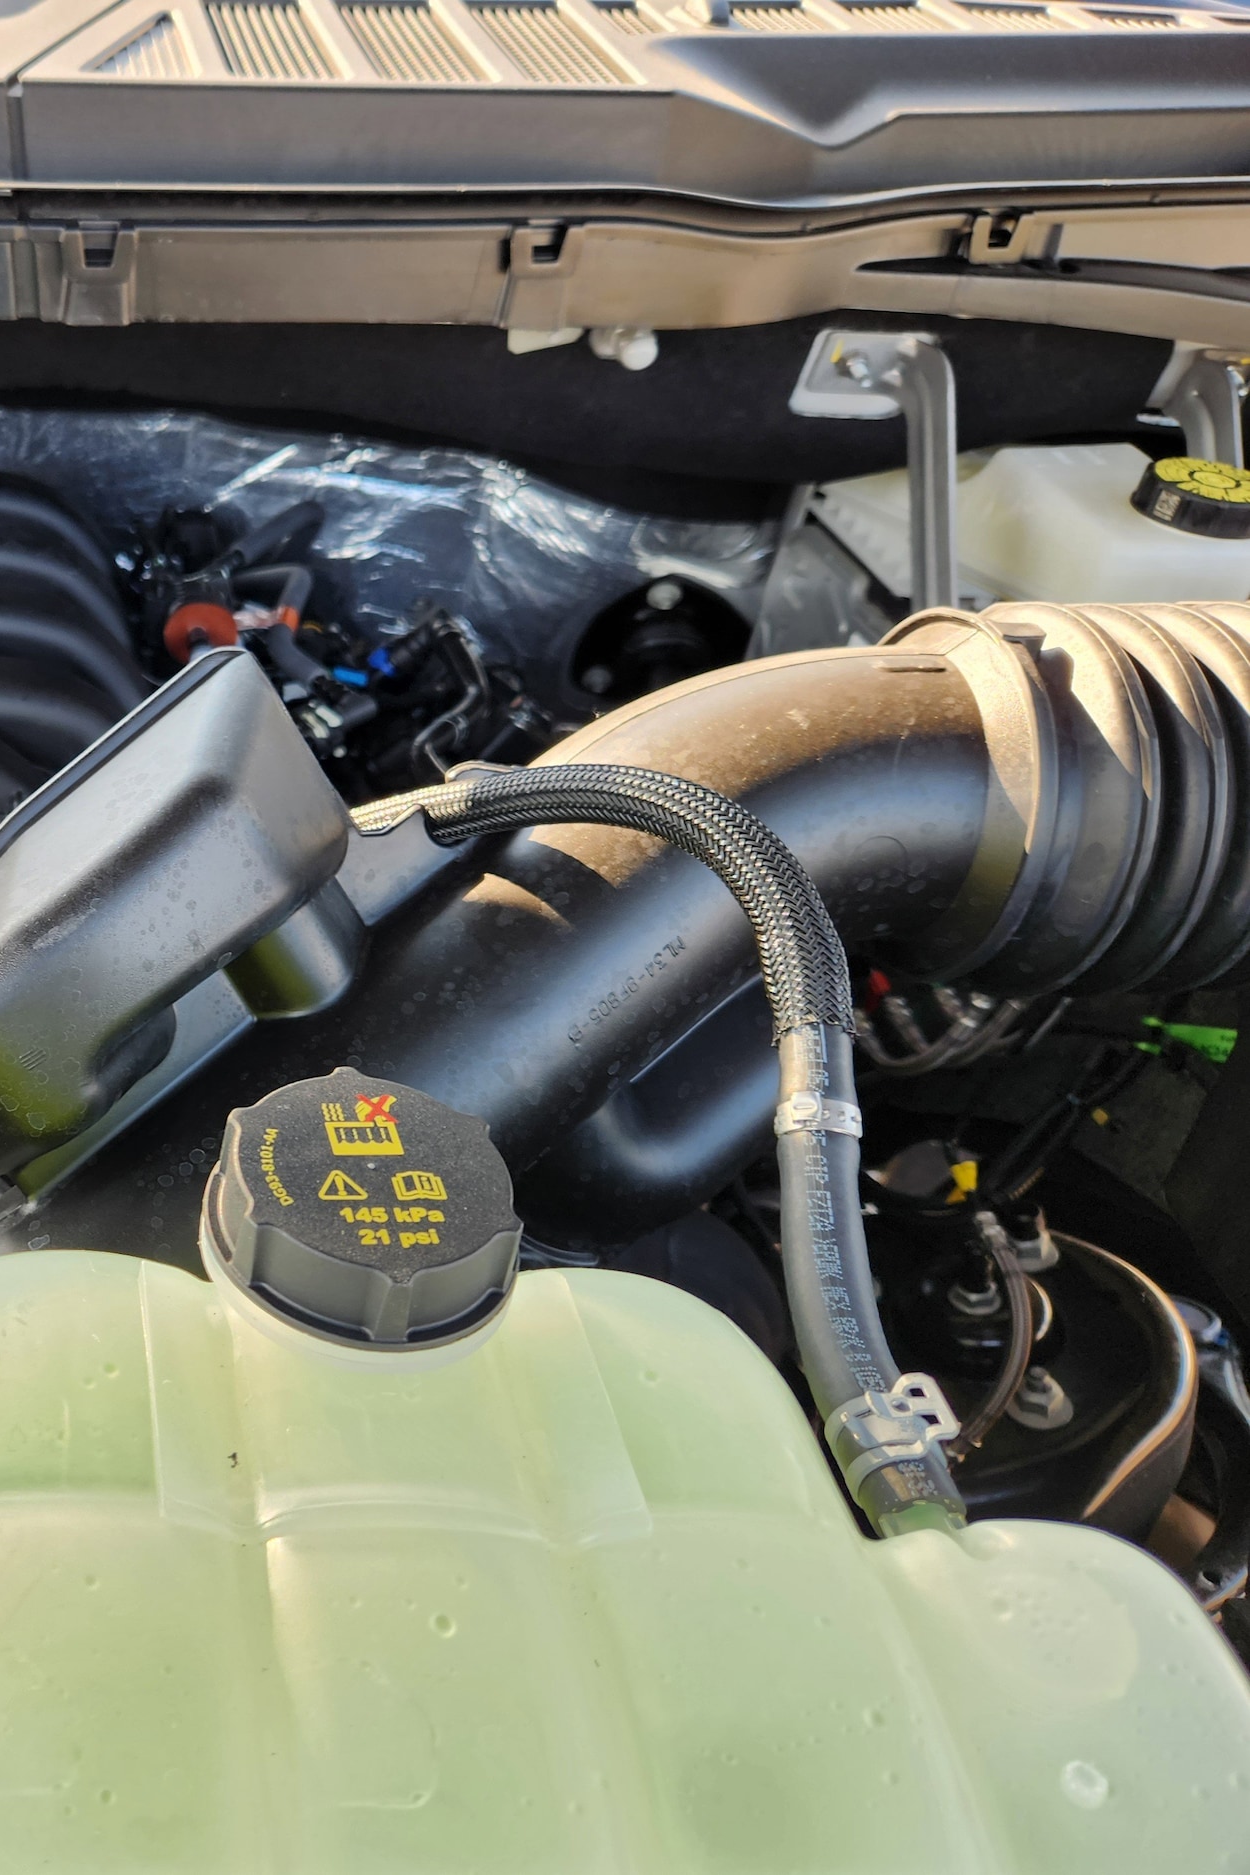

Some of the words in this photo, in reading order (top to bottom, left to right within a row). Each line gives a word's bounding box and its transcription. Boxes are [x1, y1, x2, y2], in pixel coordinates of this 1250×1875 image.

[339, 1207, 388, 1223] 145
[393, 1206, 446, 1223] kPa
[358, 1228, 391, 1246] 21
[399, 1229, 440, 1249] psi
